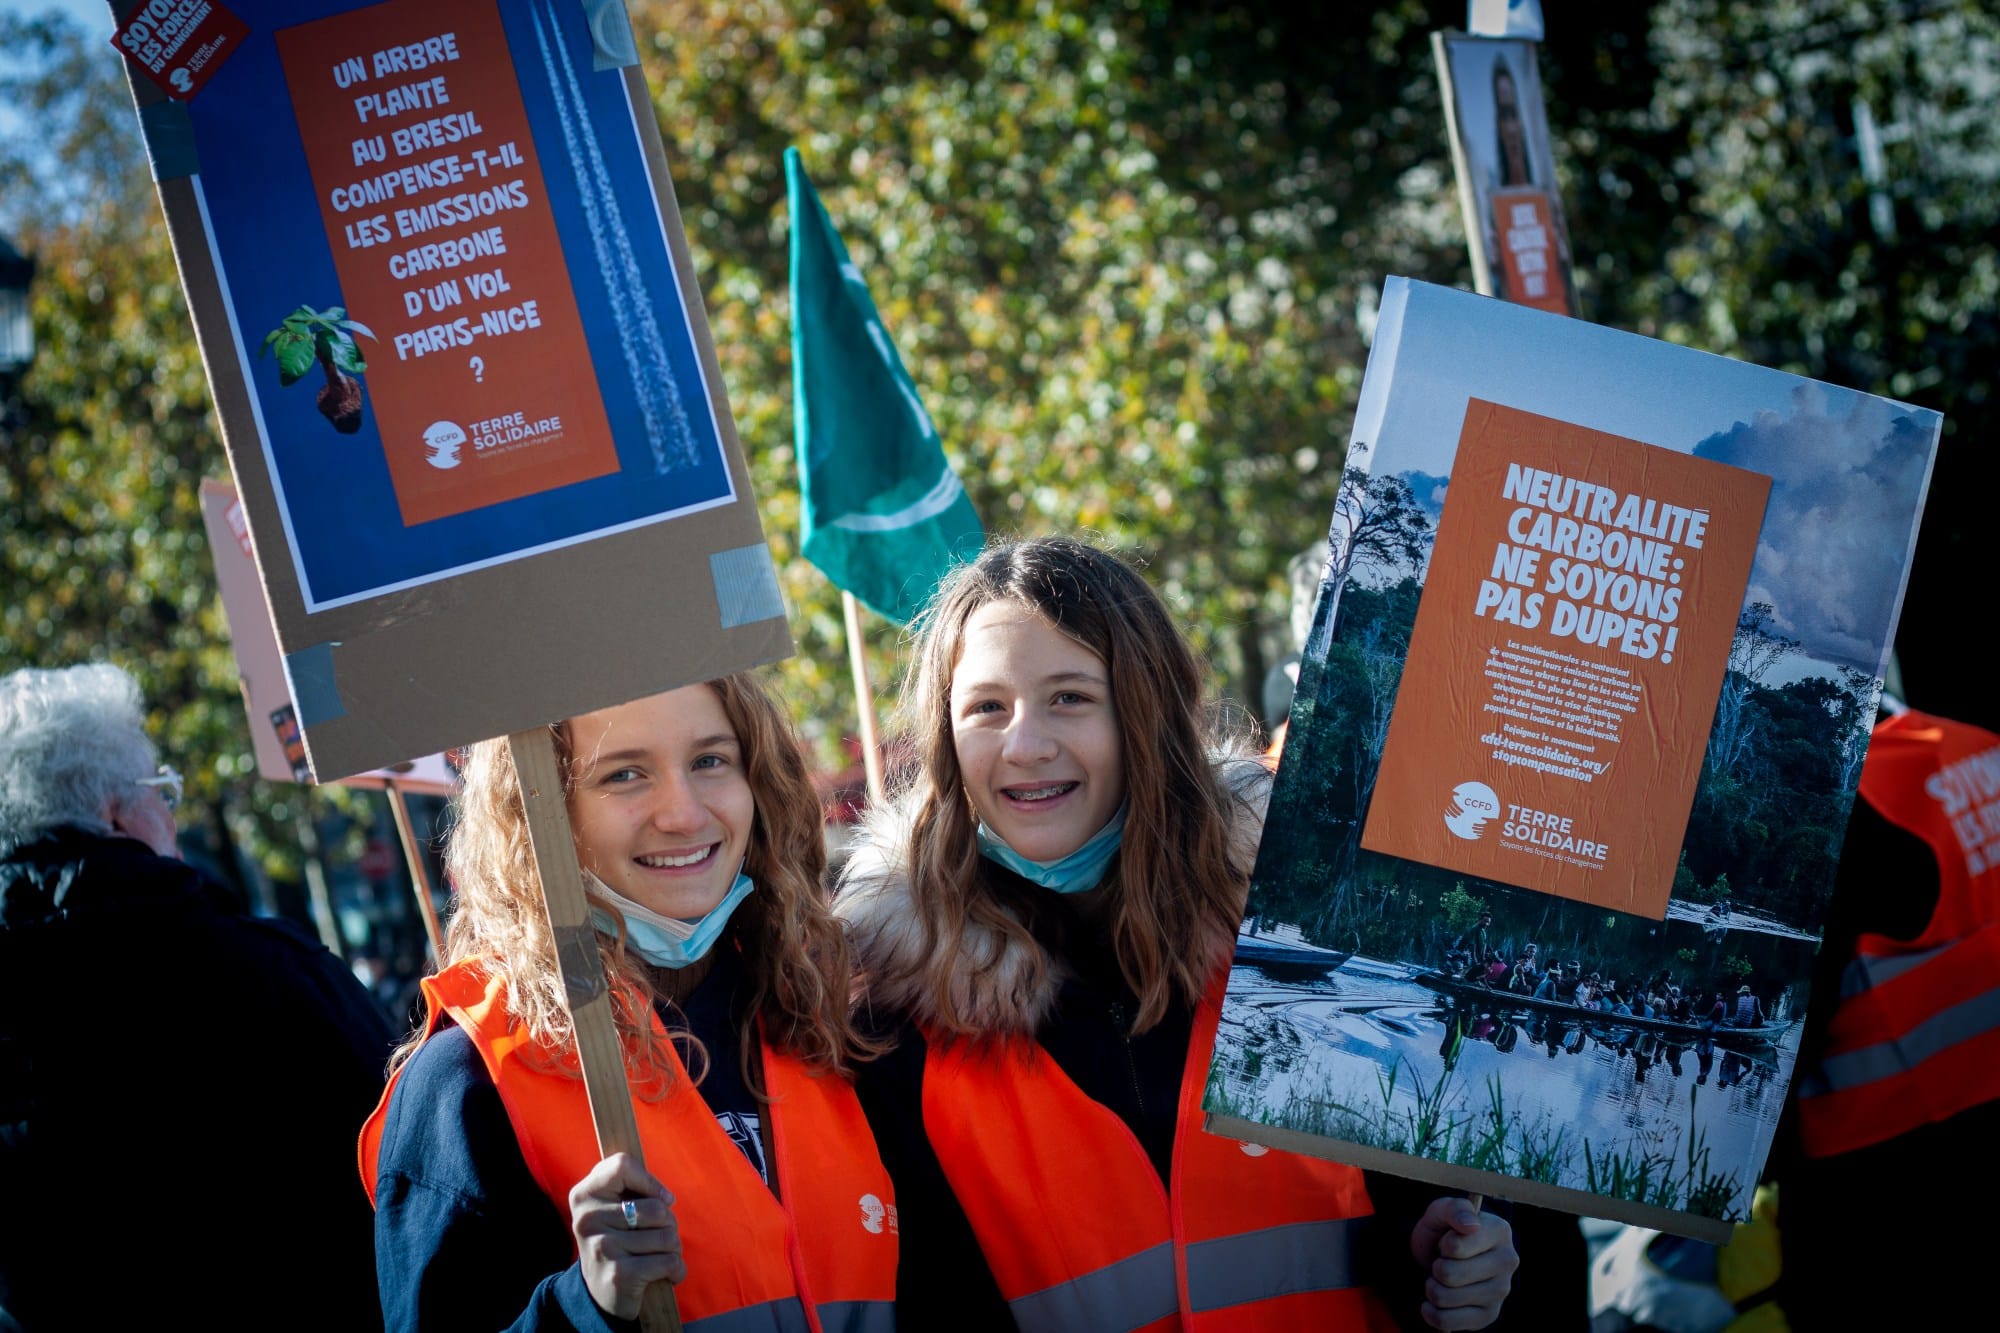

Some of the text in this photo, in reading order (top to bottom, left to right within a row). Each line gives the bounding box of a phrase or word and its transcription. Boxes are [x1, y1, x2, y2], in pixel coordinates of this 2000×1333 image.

[137, 38, 163, 66] LES
[150, 57, 166, 74] DU
[162, 1, 212, 60] CHANGEMENT
[187, 43, 209, 68] TERRE
[192, 34, 227, 73] SOLIDAIRE
[333, 32, 460, 88] UN ARBRE
[354, 76, 450, 123] PLANTE
[351, 111, 483, 166] AU BRESIL
[330, 142, 524, 212] COMPENSE-T-IL
[345, 179, 529, 249] LES EMISSIONS
[388, 226, 507, 279] CARBONE
[403, 268, 511, 318] D'UN VOL
[393, 299, 542, 360] PARIS-NICE
[468, 355, 485, 383] ?
[434, 432, 459, 444] CCFD
[469, 411, 526, 437] TERRE
[473, 416, 562, 450] SOLIDAIRE
[1502, 462, 1710, 550] NEUTRALITÉ
[1491, 542, 1683, 623] NE SOYONS
[1474, 579, 1545, 629] PAS
[1489, 646, 1642, 692] de compenser leurs émissions carbone en
[1507, 639, 1520, 649] Les
[1521, 645, 1579, 665] multinationales
[1591, 662, 1630, 677] contentent
[1486, 657, 1640, 703] plantant des arbres au lieu de les réduire
[1493, 682, 1554, 704] structurellement
[1555, 696, 1563, 706] la
[1564, 700, 1581, 710] crise
[1537, 681, 1547, 690] En
[1547, 684, 1564, 694] plus
[1566, 688, 1576, 697] de
[1588, 696, 1602, 705] pas
[1603, 699, 1637, 713] résoudre
[1483, 703, 1528, 720] populations
[1529, 712, 1555, 726] locales
[1556, 721, 1565, 729] et
[1566, 721, 1574, 731] la
[1493, 693, 1508, 704] cela
[1516, 699, 1530, 709] des
[1531, 702, 1560, 716] impacts
[1561, 711, 1591, 724] négatifs
[1593, 719, 1606, 728] sur
[1607, 720, 1618, 731] les
[1503, 723, 1595, 753] Rejoignez le mouvement
[1491, 749, 1593, 783] stopcompensation
[1464, 798, 1493, 811] CCFD
[1507, 803, 1574, 834] TERRE
[1499, 839, 1604, 871] Soyons les forces du changement
[1502, 821, 1609, 861] SOLIDAIRE
